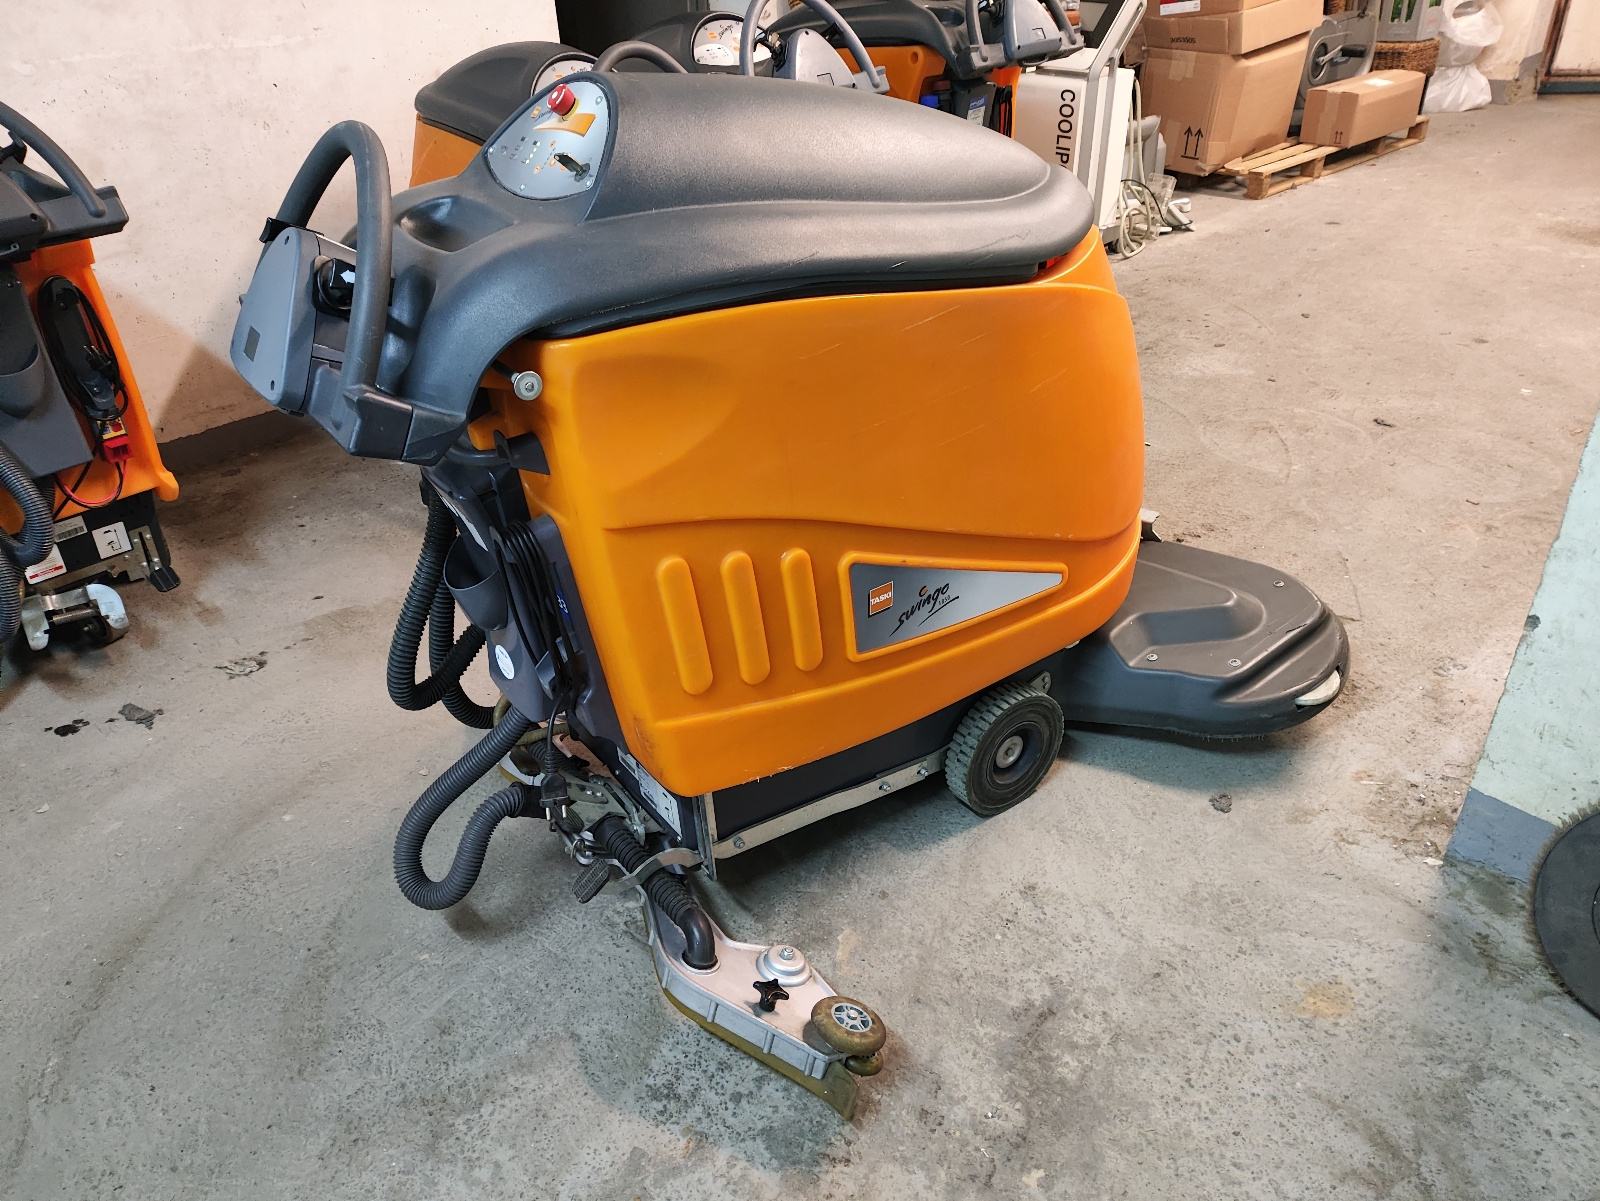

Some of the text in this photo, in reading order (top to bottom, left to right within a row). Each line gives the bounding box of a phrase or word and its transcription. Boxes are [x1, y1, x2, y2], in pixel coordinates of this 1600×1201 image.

[1056, 89, 1075, 168] COOLIP
[870, 592, 892, 606] TASKI
[889, 583, 950, 637] swingo
